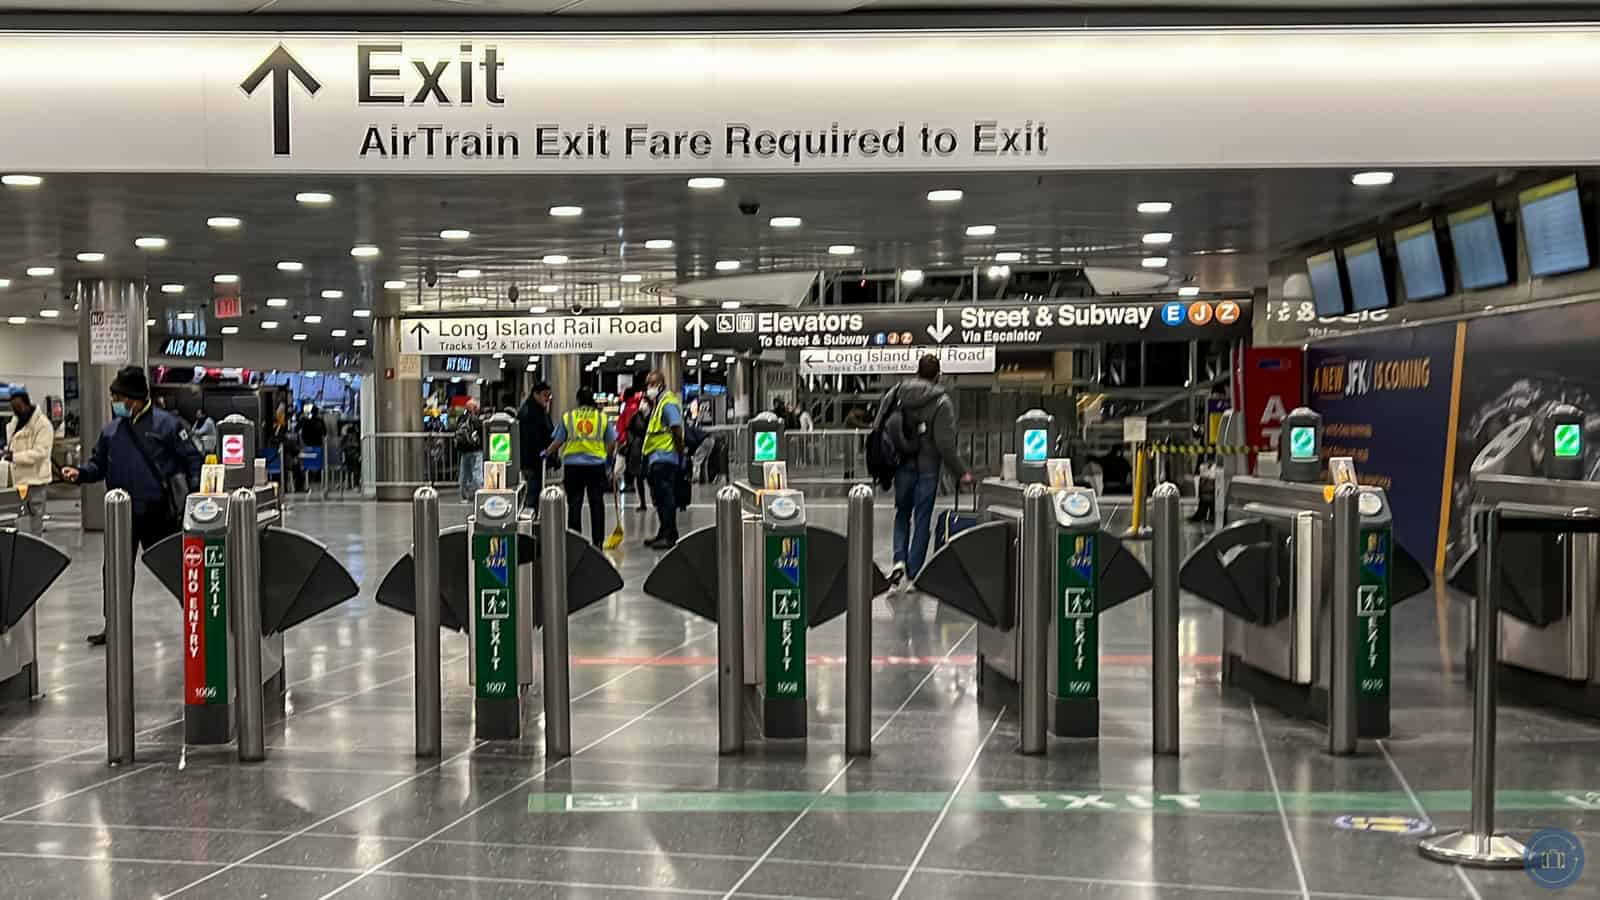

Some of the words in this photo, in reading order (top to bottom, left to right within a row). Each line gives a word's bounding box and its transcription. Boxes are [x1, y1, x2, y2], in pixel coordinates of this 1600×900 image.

[357, 41, 505, 106] Exit
[359, 123, 519, 158] AirTrain
[535, 123, 609, 158] Exit
[624, 123, 712, 158] Fare
[725, 121, 906, 165] Required
[920, 122, 958, 156] to
[973, 120, 1049, 156] Exit
[438, 320, 488, 341] Long
[496, 319, 554, 337] Island
[563, 317, 601, 336] Rail
[609, 316, 663, 334] Road
[758, 312, 863, 333] Elevators
[961, 307, 1030, 328] Street
[1036, 306, 1053, 327] &
[1058, 304, 1154, 329] Subway
[1166, 307, 1181, 321] E
[1221, 305, 1235, 320] Z
[165, 338, 185, 356] AIR
[440, 342, 473, 351] Tracks
[476, 341, 498, 351] 1-12
[511, 340, 542, 350] Ticket
[544, 339, 593, 350] Machines
[759, 335, 773, 347] To
[775, 335, 809, 347] Street
[812, 335, 820, 346] &
[823, 334, 870, 348] Subway
[961, 330, 981, 343] Via
[826, 350, 863, 364] Long
[867, 349, 911, 362] Island
[947, 348, 985, 361] Road
[1384, 357, 1432, 391] COMING
[187, 568, 199, 593] NO
[209, 568, 221, 617] EXIT
[188, 597, 200, 658] ENTRY
[490, 620, 501, 671] EXIT
[782, 620, 793, 671] EXIT
[1074, 618, 1086, 671] EXIT
[999, 794, 1200, 809] EXIT
